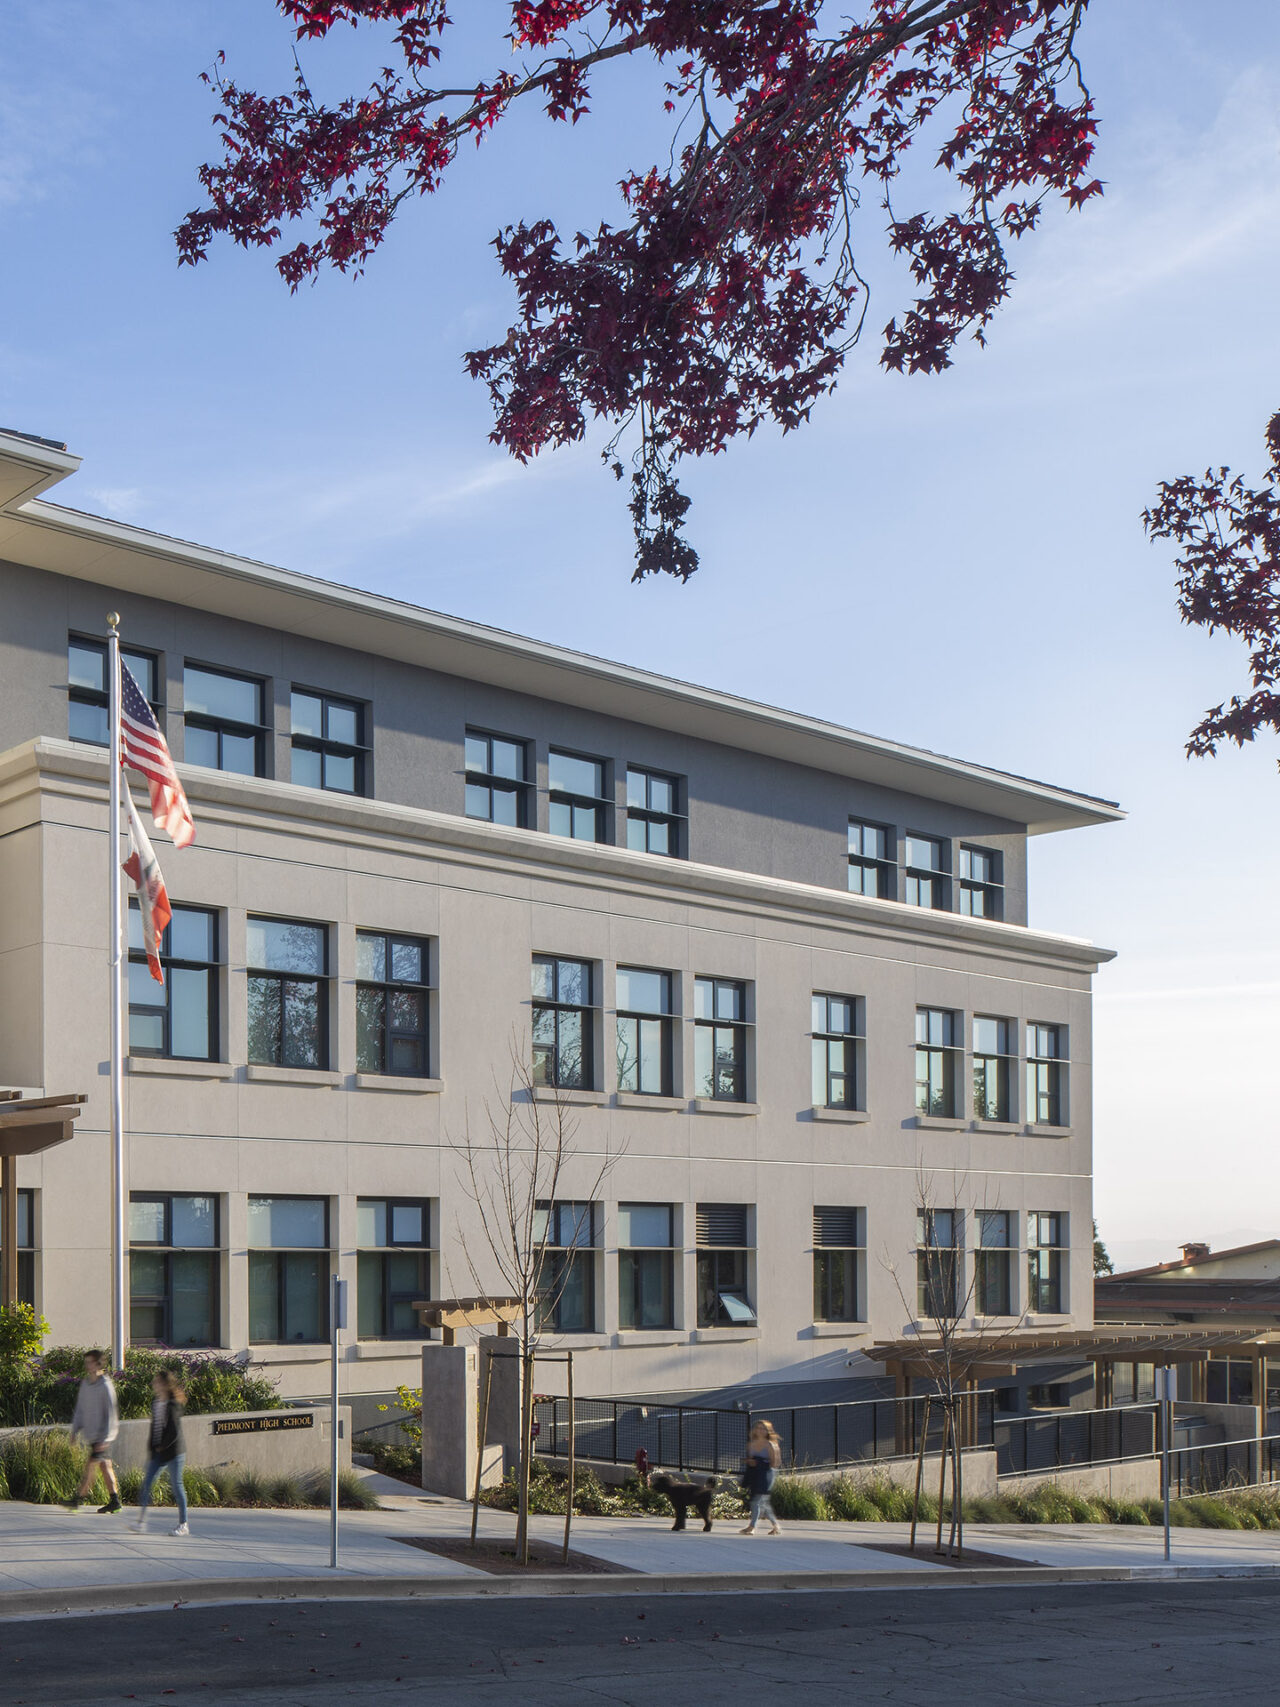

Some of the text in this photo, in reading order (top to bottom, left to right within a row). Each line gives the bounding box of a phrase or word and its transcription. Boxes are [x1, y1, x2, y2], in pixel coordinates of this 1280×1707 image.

[217, 1417, 311, 1431] PIEDMONT HIGH SCHOOL
